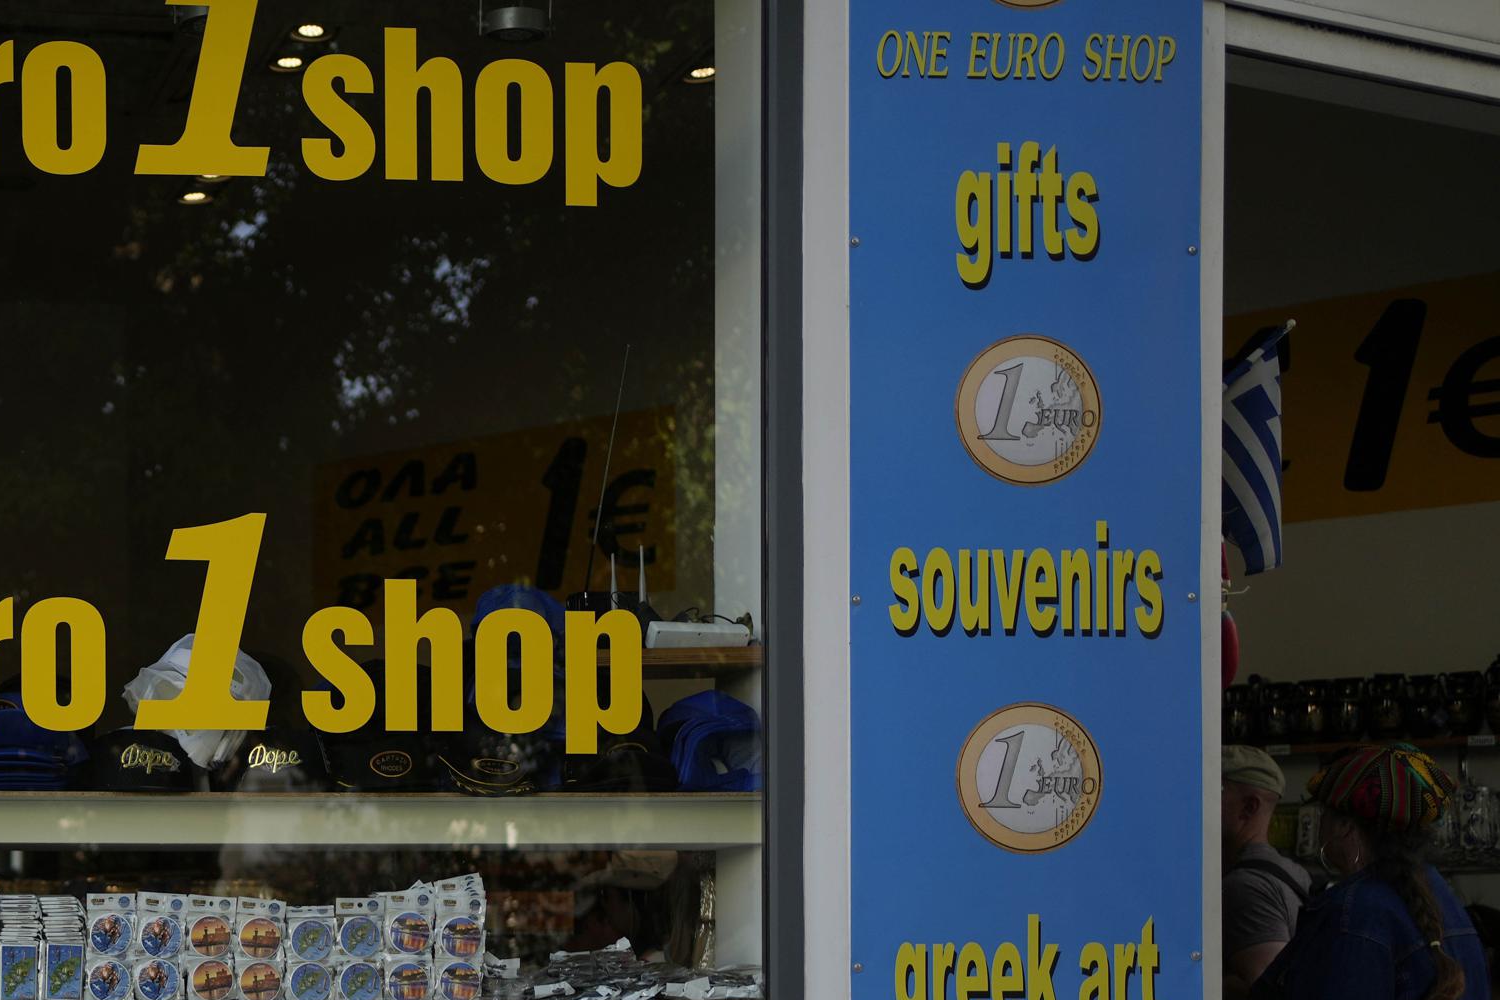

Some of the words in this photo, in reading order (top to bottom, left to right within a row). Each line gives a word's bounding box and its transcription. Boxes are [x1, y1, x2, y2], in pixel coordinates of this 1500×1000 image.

[876, 29, 951, 79] ONE
[967, 31, 1066, 80] EURO
[1082, 33, 1177, 82] SHOP
[134, 0, 270, 176] 1
[300, 26, 643, 207] shop
[955, 140, 1100, 290] gifts
[977, 362, 1024, 441] 1
[1038, 407, 1096, 428] EURO
[341, 506, 470, 561] ALL
[888, 519, 1165, 640] souvenirs
[134, 512, 270, 731] 1
[301, 578, 643, 755] shop
[121, 742, 176, 775] Dope
[248, 742, 303, 774] Dope
[978, 730, 1025, 809] 1
[1039, 775, 1097, 796] EURO
